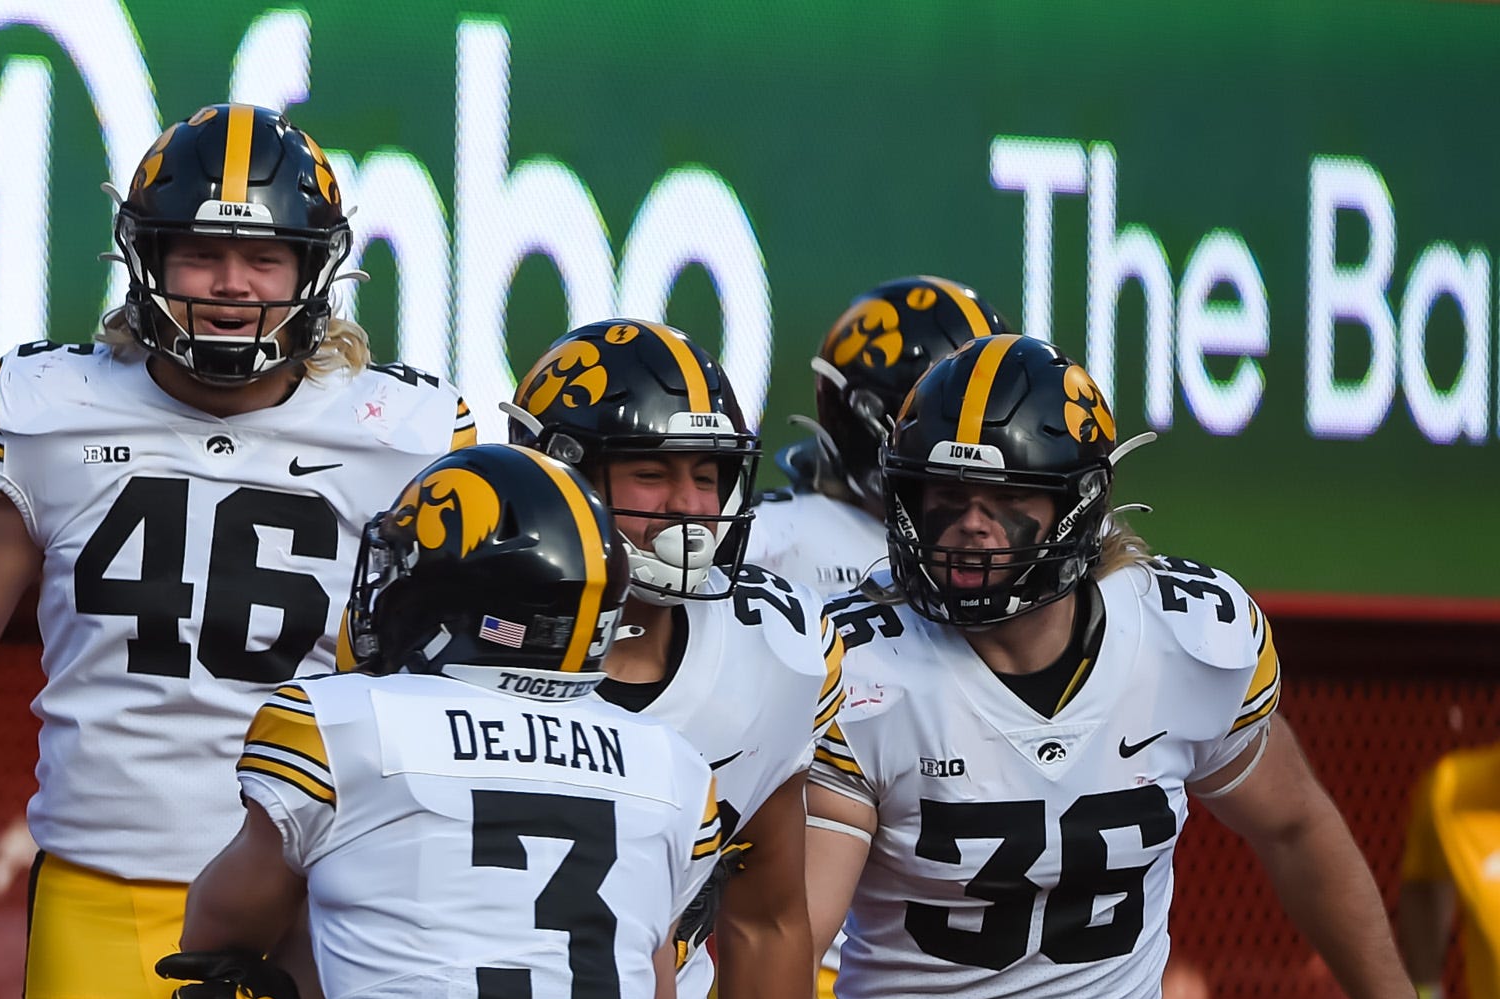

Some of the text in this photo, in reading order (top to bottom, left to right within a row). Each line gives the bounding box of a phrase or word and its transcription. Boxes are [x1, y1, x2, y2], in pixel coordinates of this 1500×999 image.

[218, 203, 253, 217] IOWA
[228, 8, 772, 446] nbo
[990, 134, 1500, 446] The Ba
[689, 414, 720, 428] IOWA
[949, 444, 983, 461] IOWA
[74, 475, 339, 685] 46
[1148, 554, 1237, 624] 36
[903, 783, 1178, 972] 36
